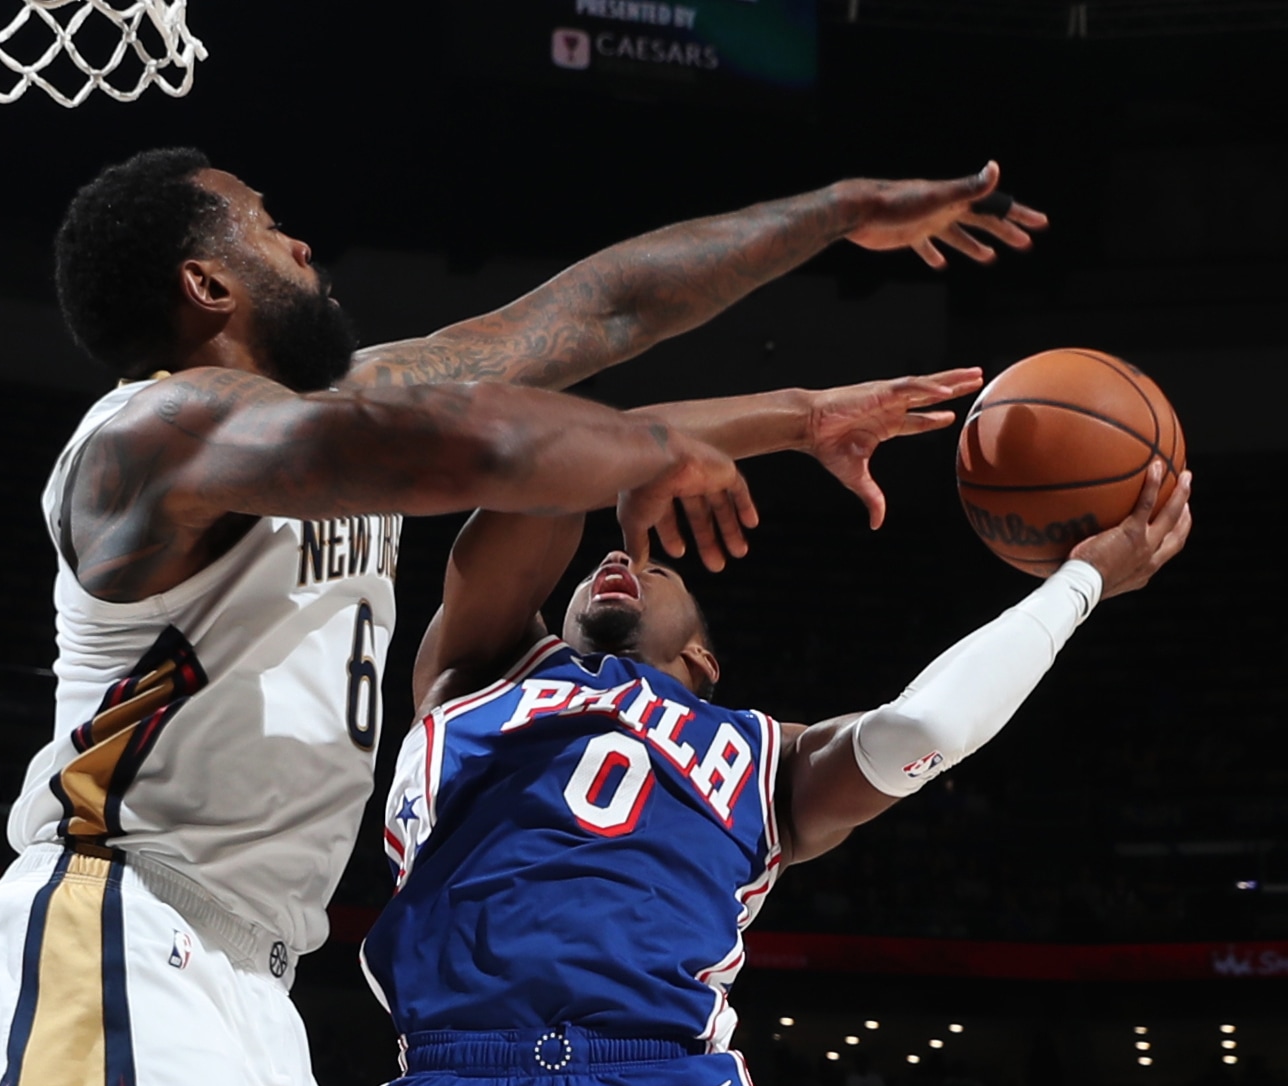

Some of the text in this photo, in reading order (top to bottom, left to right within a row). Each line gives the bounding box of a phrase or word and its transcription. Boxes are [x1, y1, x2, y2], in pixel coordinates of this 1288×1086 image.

[595, 31, 720, 71] CAESARS
[673, 5, 697, 30] BY
[296, 516, 372, 587] NEW
[969, 504, 1103, 547] Wilson
[346, 598, 378, 752] 6
[500, 677, 754, 830] PHILA
[563, 730, 656, 839] 0
